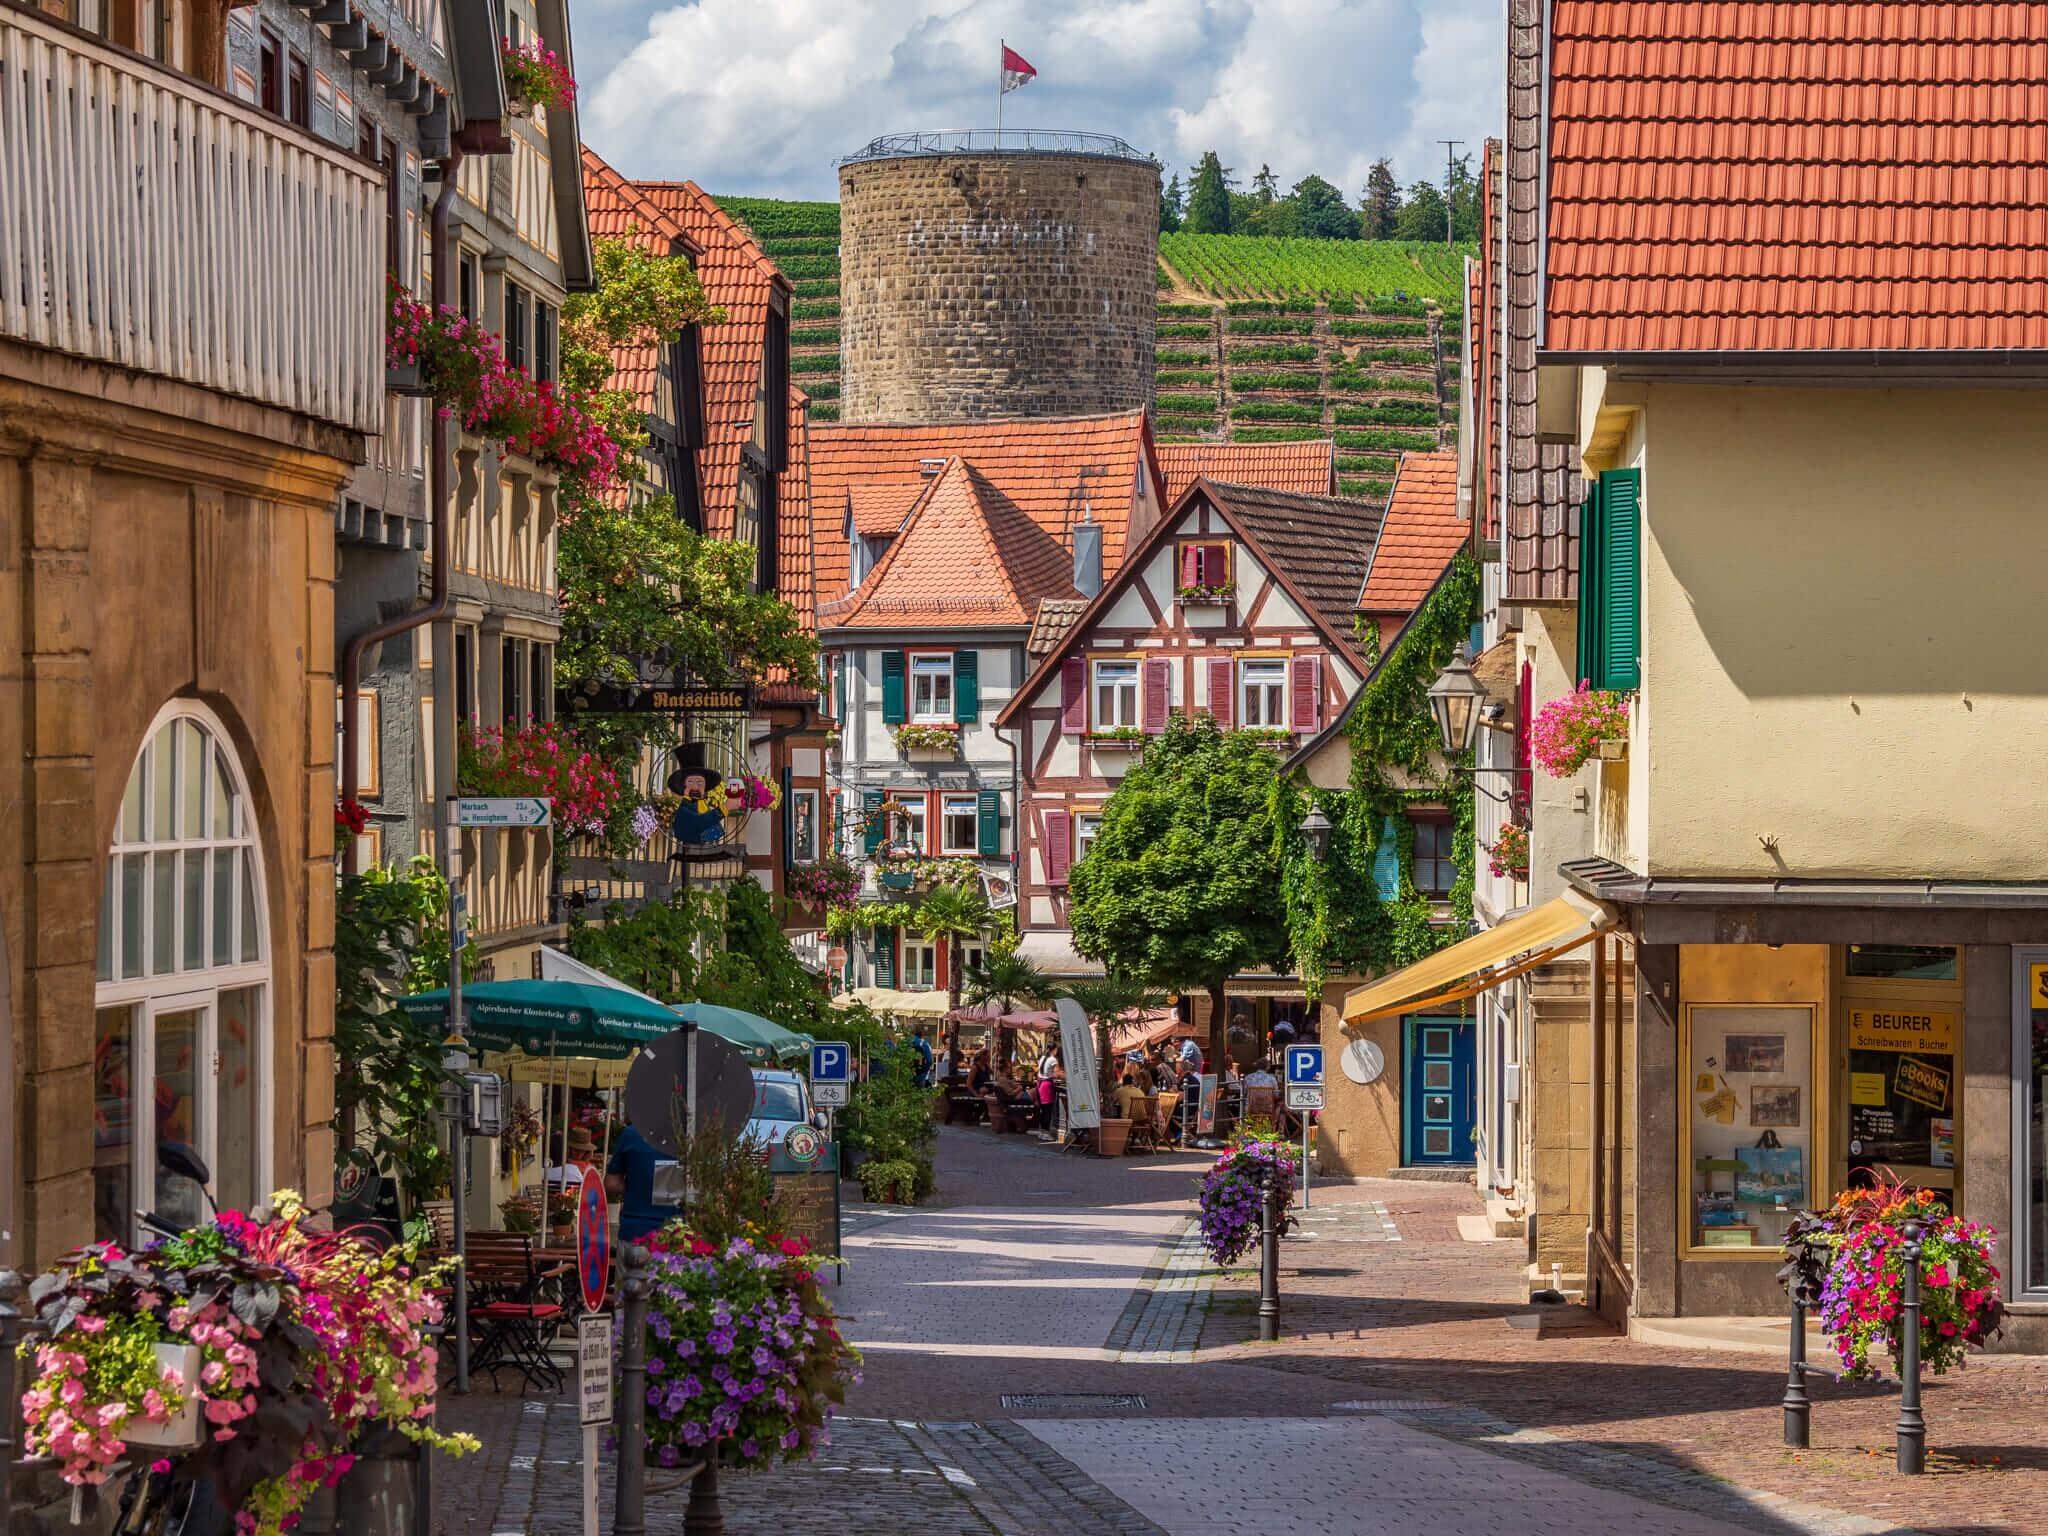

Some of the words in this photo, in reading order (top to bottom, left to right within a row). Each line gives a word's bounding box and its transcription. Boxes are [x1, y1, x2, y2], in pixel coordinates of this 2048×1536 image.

[653, 691, 743, 708] Ratsstüble
[477, 1004, 521, 1015] Alpirsbacher
[523, 1007, 565, 1019] Klosterbräu
[1872, 1014, 1931, 1031] BEURER
[1857, 1035, 1912, 1048] Schreibwaren
[820, 1049, 839, 1075] P
[1296, 1052, 1314, 1078] P
[1901, 1064, 1944, 1091] eBooks
